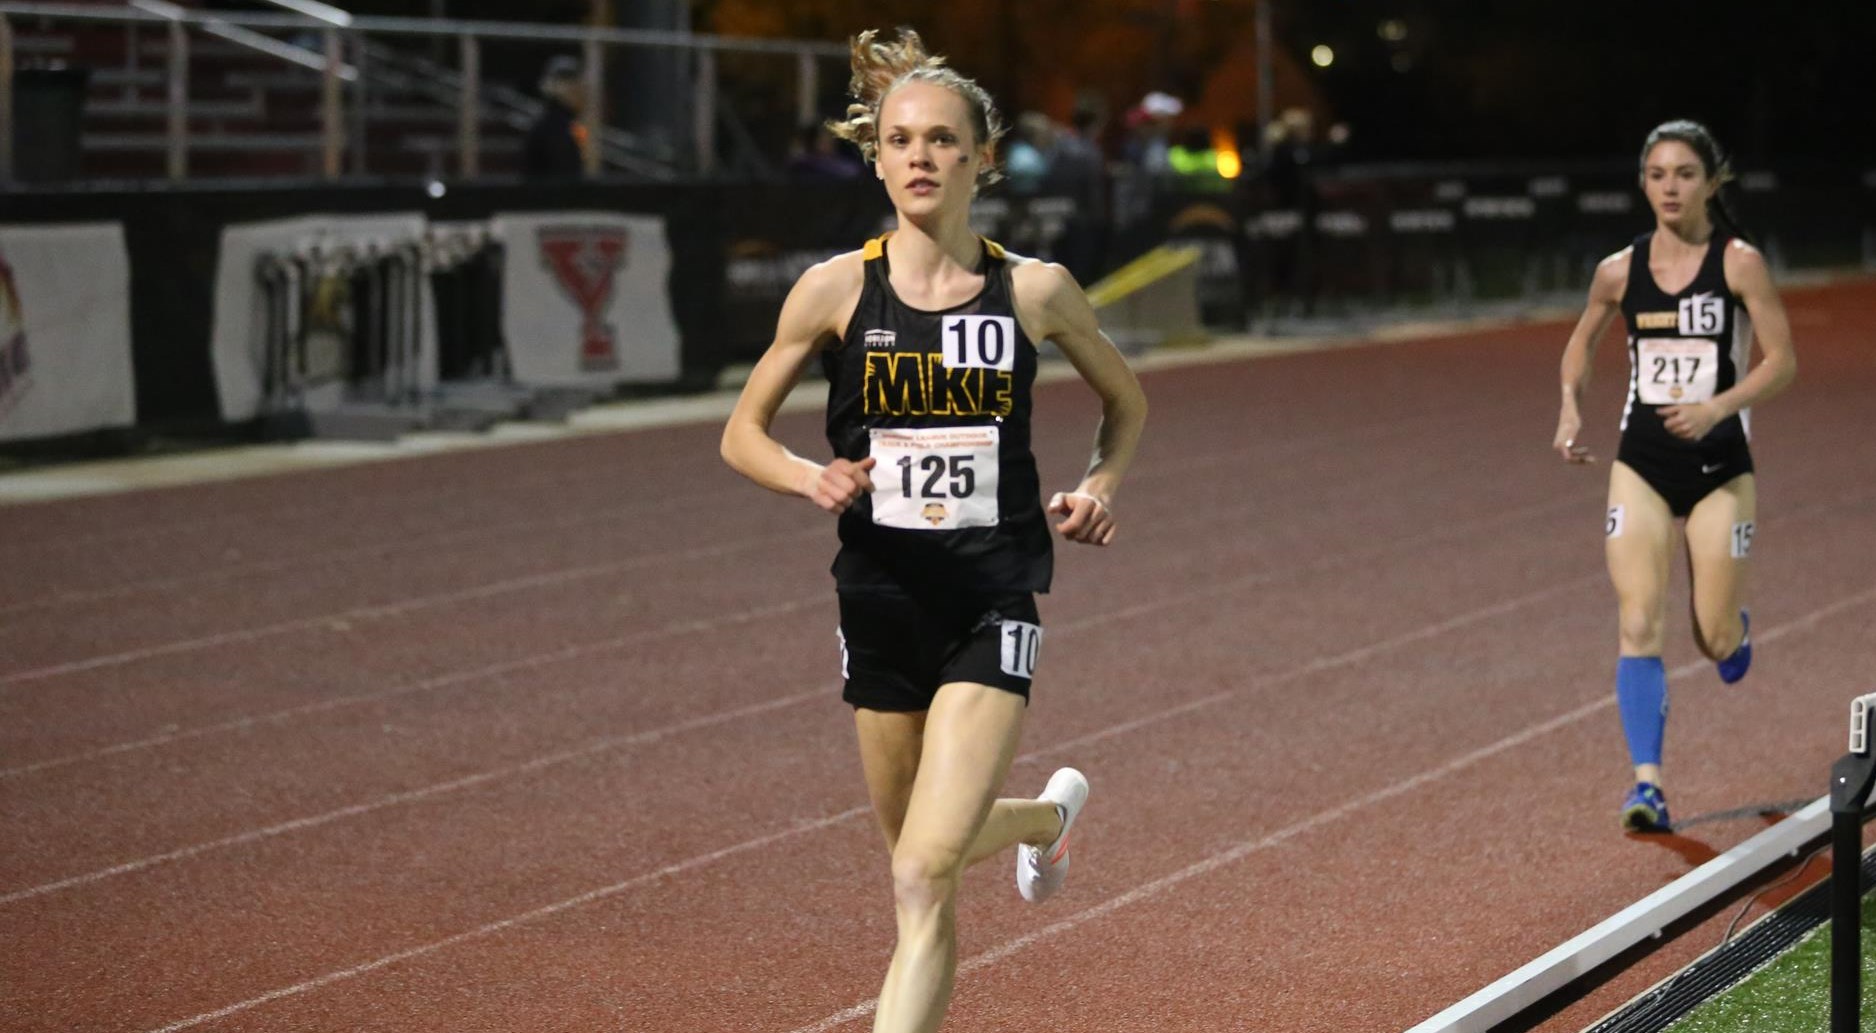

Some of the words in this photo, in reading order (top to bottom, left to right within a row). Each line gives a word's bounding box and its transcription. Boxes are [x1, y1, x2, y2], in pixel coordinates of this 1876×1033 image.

[535, 225, 627, 371] Y
[1683, 301, 1717, 331] 15
[948, 318, 1004, 366] 10
[863, 351, 1013, 417] MKE
[1651, 356, 1701, 385] 217
[896, 454, 976, 500] 125
[1007, 624, 1041, 676] 10
